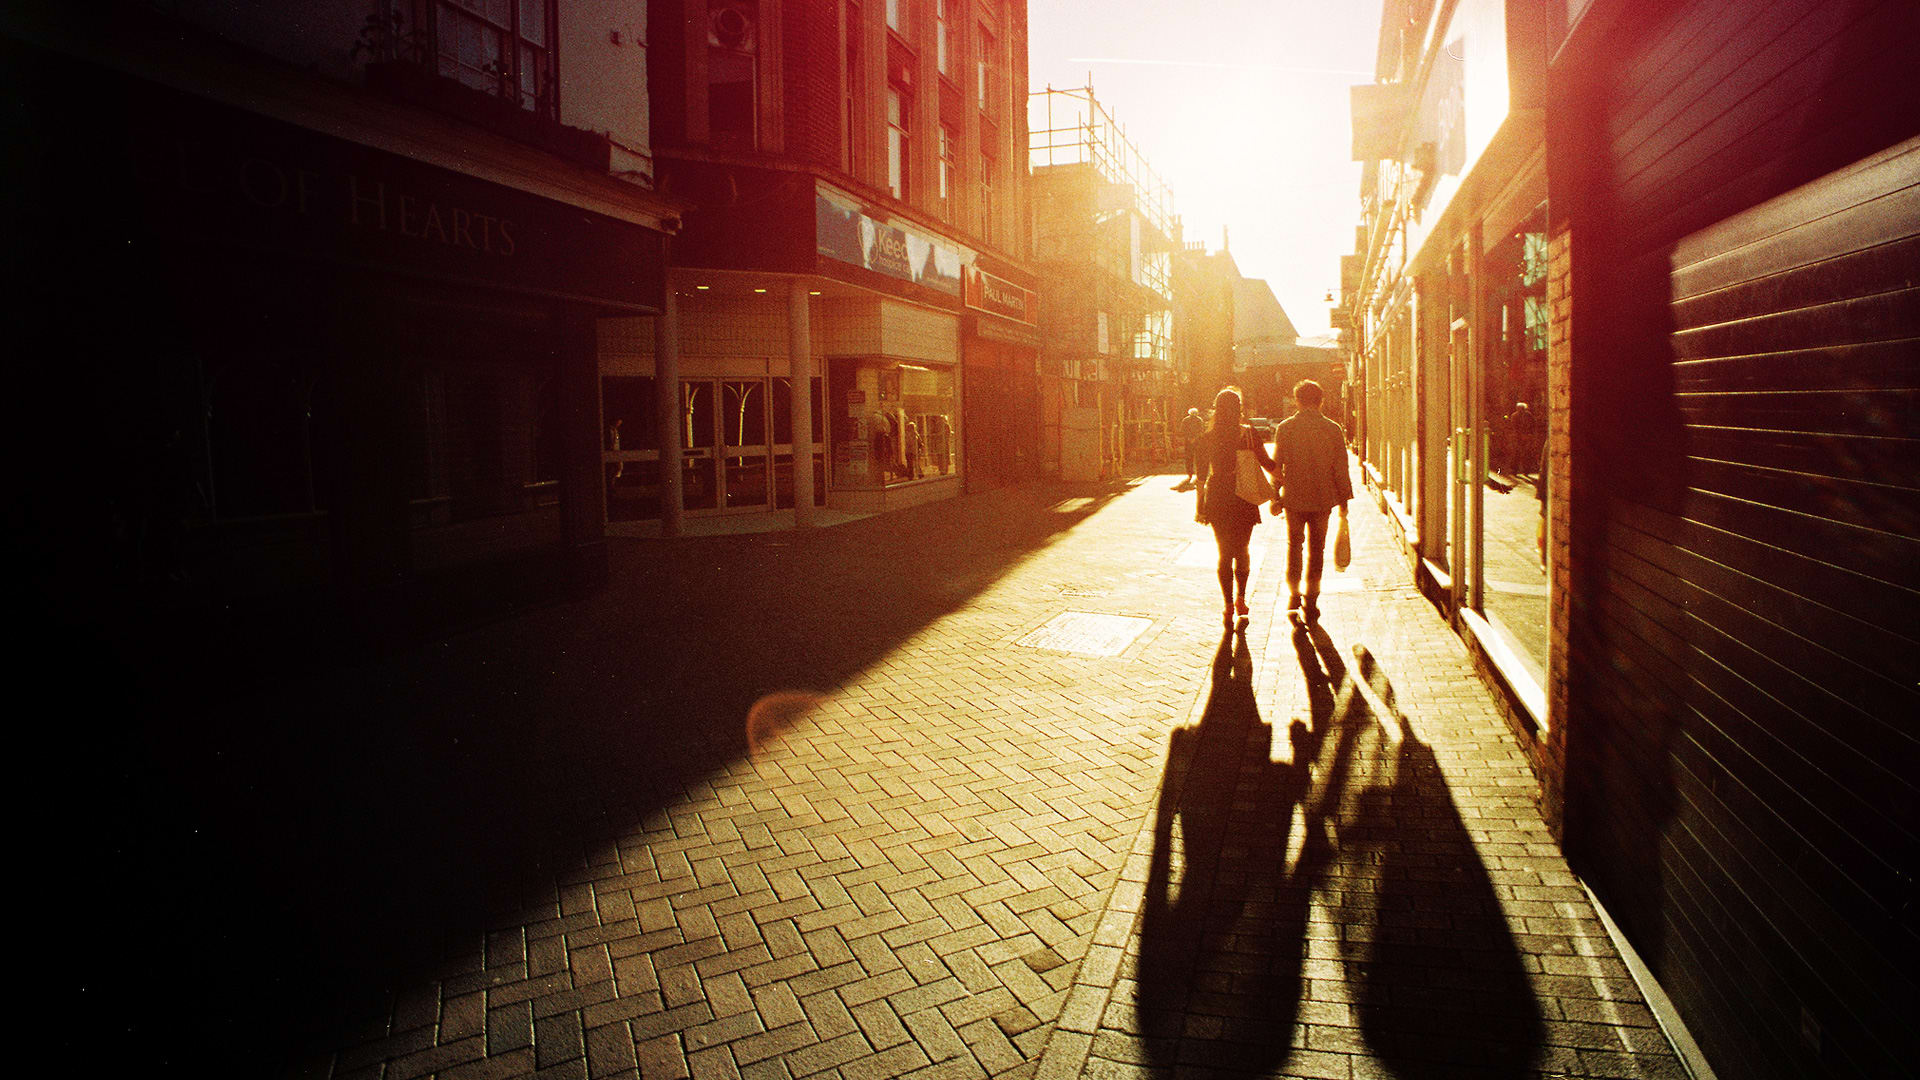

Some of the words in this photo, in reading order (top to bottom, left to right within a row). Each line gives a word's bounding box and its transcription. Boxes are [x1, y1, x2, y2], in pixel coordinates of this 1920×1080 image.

[240, 156, 320, 217] OF
[348, 175, 516, 258] HEARTS
[984, 285, 1002, 303] PAUL
